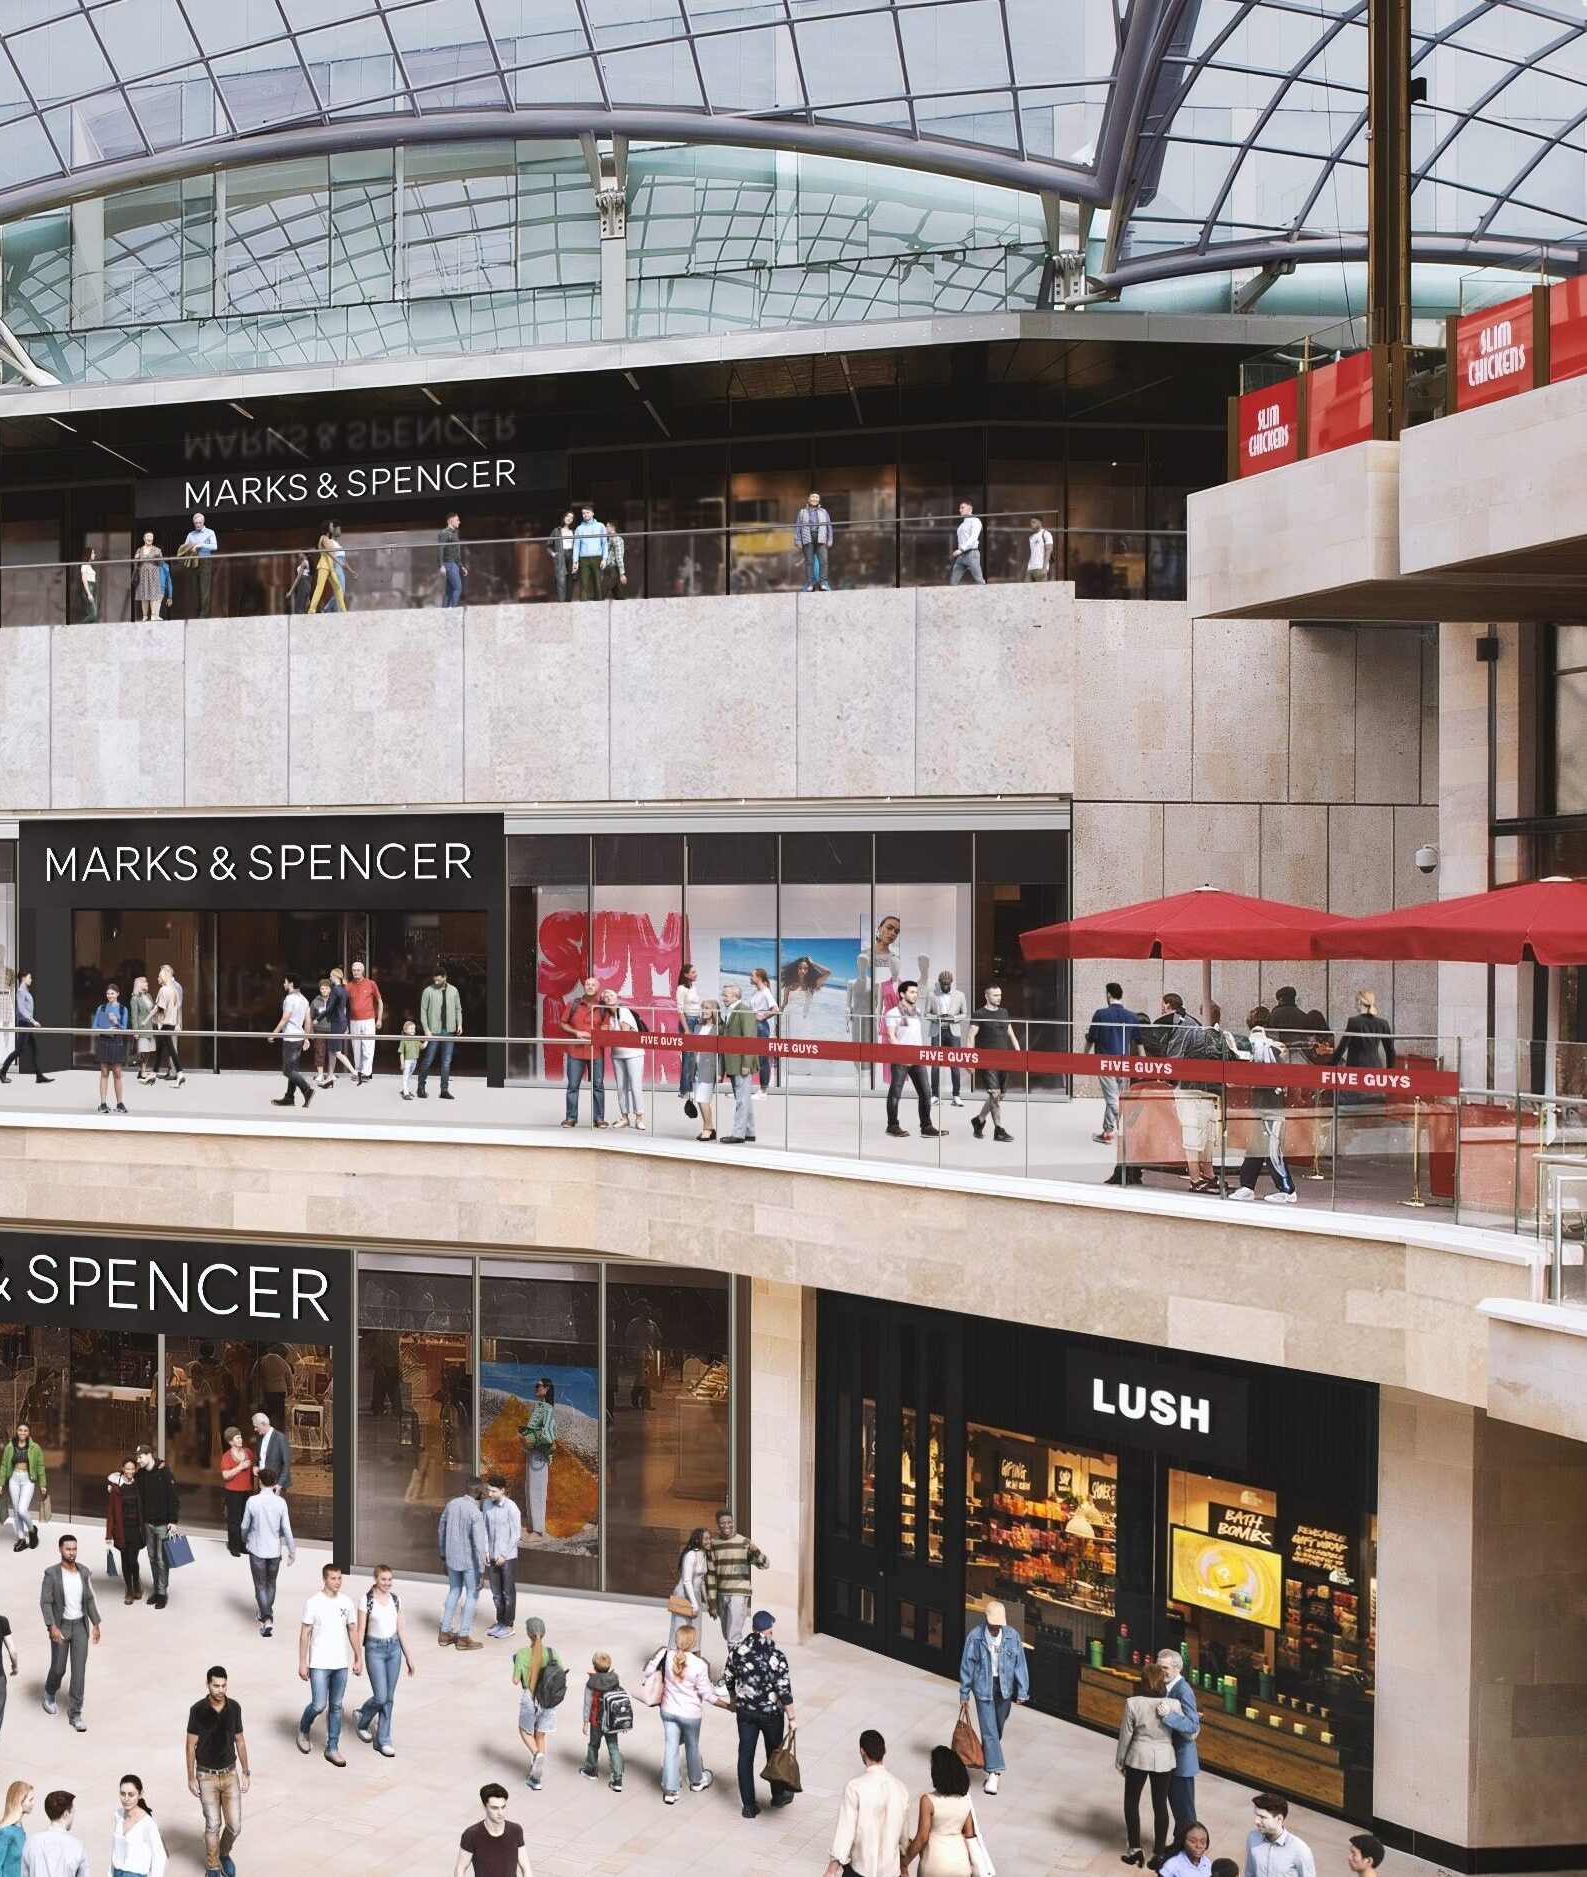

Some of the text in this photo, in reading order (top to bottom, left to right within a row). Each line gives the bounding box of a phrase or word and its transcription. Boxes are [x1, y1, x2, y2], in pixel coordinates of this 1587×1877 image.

[1480, 320, 1512, 356] SLIM
[1468, 343, 1526, 387] CHICKENS
[1257, 404, 1280, 432] SLIM
[1248, 424, 1289, 457] CHICKENS
[184, 459, 516, 508] MARKS & SPENCER
[45, 842, 473, 882] MARKS & SPENCER
[640, 1035, 684, 1047] FIVE GUYS
[768, 1042, 819, 1055] FIVE GUYS
[919, 1050, 979, 1064] FIVE GUYS
[1100, 1059, 1173, 1075] FIVE GUYS
[1321, 1071, 1411, 1089] FIVE GUYS
[26, 1254, 330, 1322] SPENCER
[1093, 1378, 1210, 1434] LUSH
[1224, 1509, 1264, 1530] BATH
[1217, 1522, 1273, 1546] BOMBS
